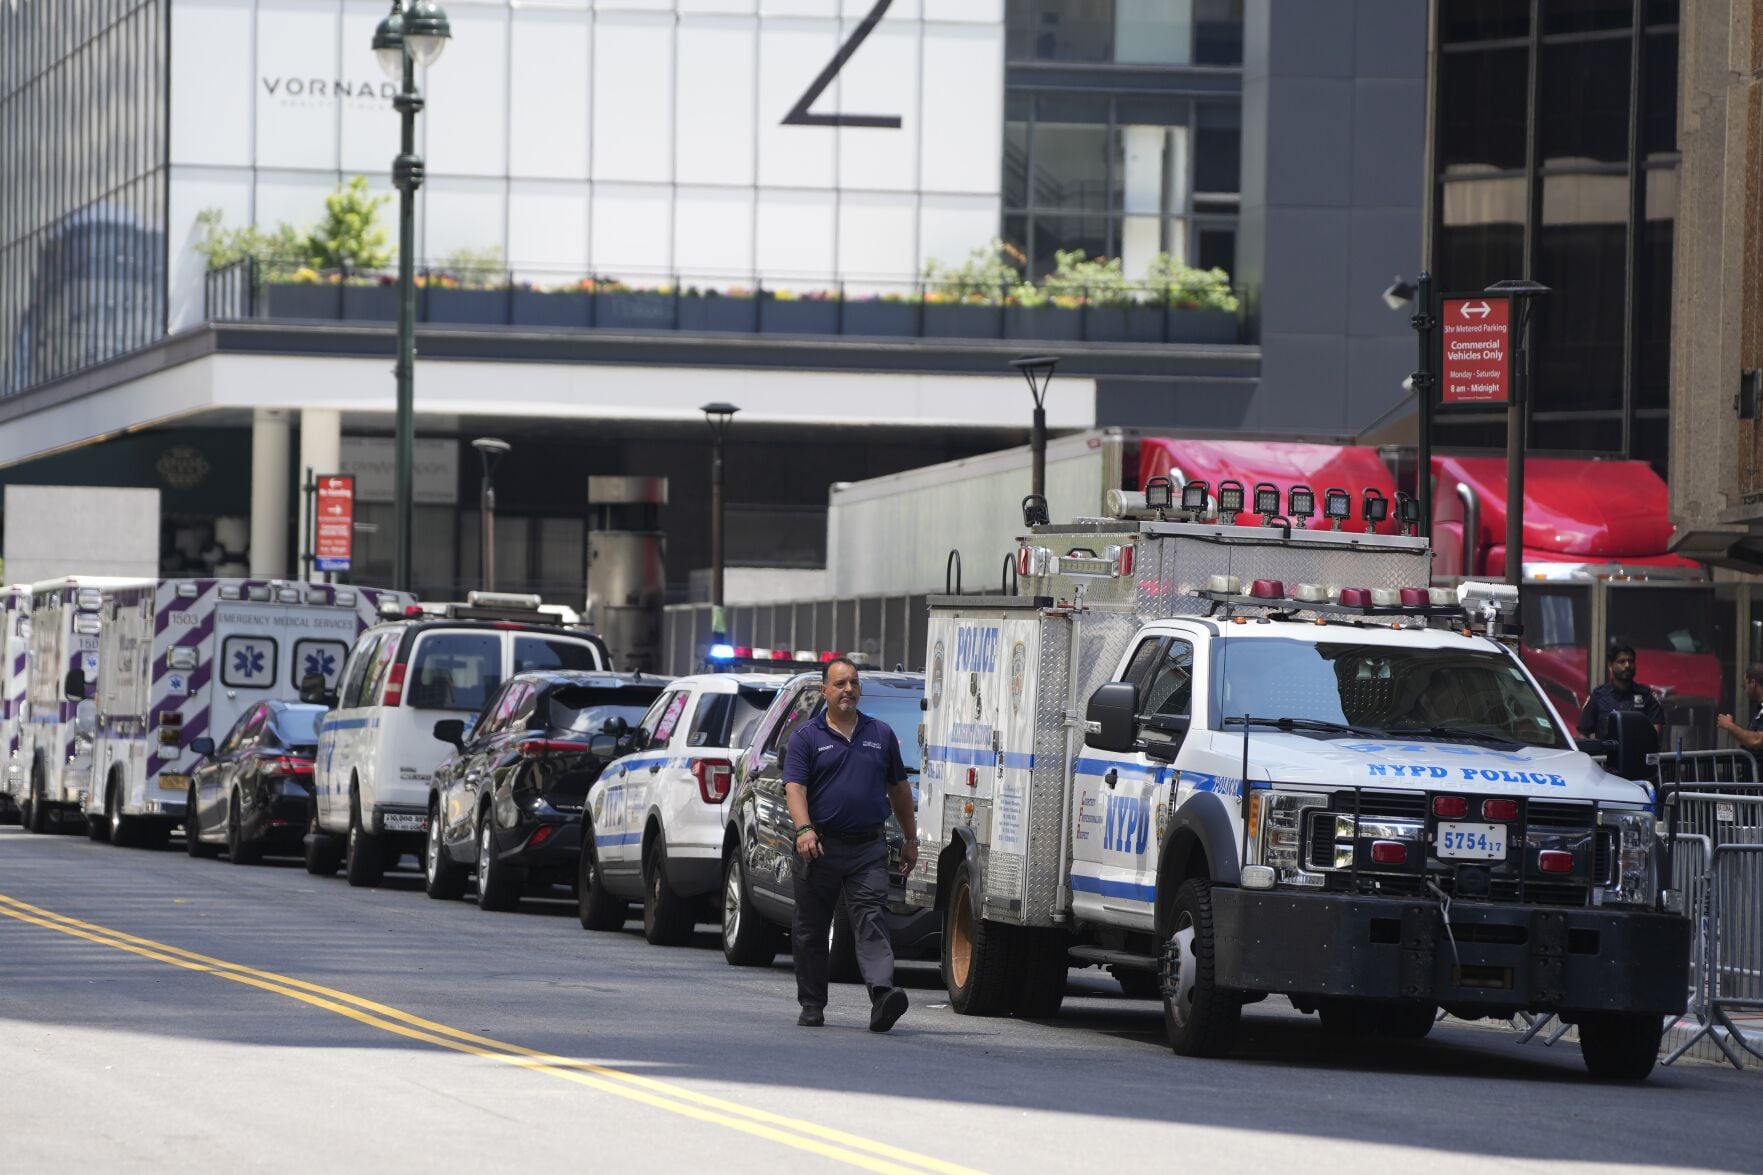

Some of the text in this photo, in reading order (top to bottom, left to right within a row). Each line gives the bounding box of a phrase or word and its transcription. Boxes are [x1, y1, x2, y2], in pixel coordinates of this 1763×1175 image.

[263, 77, 418, 98] VORNAD
[1444, 323, 1507, 334] 3hr Metered Parking
[1451, 340, 1500, 350] Commercial
[1448, 350, 1503, 361] Vehicles Only
[1450, 370, 1472, 379] Monday
[1476, 369, 1500, 378] Saturday
[1450, 384, 1455, 393] 8
[1471, 383, 1500, 394] Midnight
[171, 614, 198, 625] 1503
[219, 613, 353, 630] EMERGENCY MEDICAL SERVICES
[78, 638, 99, 649] 150
[955, 626, 999, 673] POLICE
[1367, 763, 1567, 787] NYPD POLICE
[1104, 794, 1150, 854] NYPD
[1444, 832, 1502, 852] 5754 17
